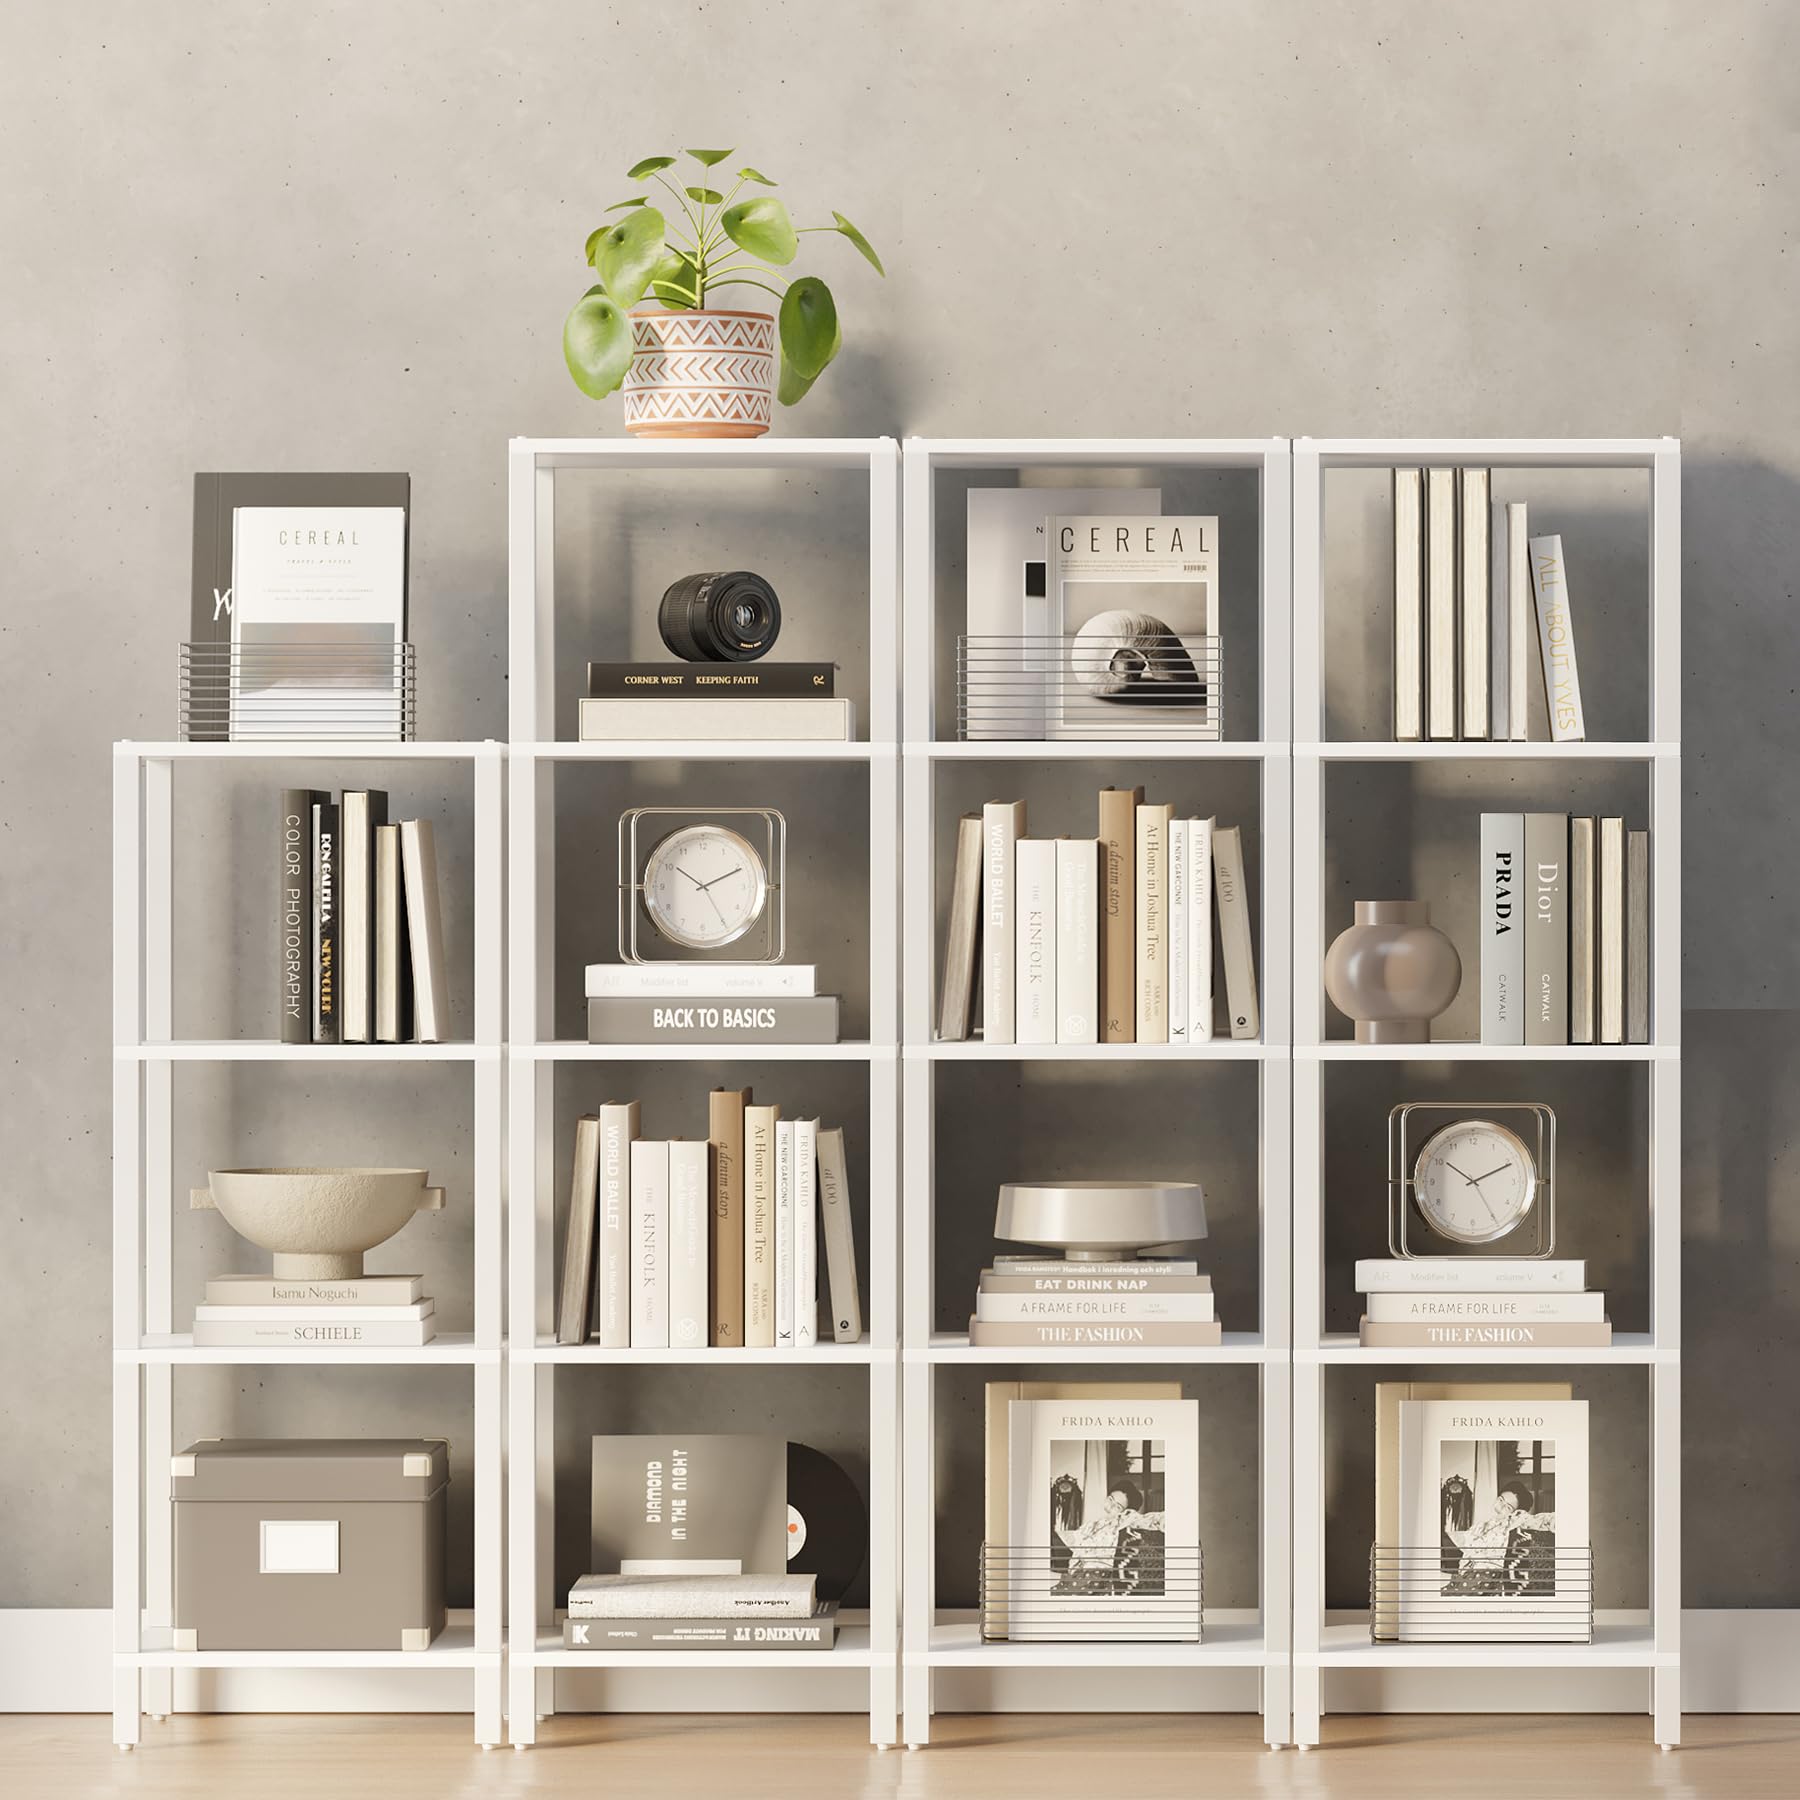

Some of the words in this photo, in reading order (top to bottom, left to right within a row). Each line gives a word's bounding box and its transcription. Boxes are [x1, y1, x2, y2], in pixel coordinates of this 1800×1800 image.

[279, 530, 359, 546] CEREAL
[1061, 527, 1209, 552] CEREAL
[1537, 556, 1559, 592] ALL
[1544, 602, 1570, 669] ABOUT
[625, 675, 659, 685] CORNER
[661, 675, 684, 685] WEST
[696, 675, 731, 685] KEEPING
[733, 675, 759, 685] FAITH
[1553, 680, 1576, 730] YVES
[1146, 824, 1160, 838] At
[285, 814, 301, 876] COLOR
[320, 833, 332, 861] RON
[991, 824, 1004, 875] WORLD
[665, 863, 674, 871] 10
[1109, 849, 1124, 884] denim
[1146, 841, 1160, 877] Home
[1146, 879, 1160, 890] in
[1496, 852, 1512, 936] PRADA
[1537, 862, 1558, 923] Dior
[991, 878, 1004, 928] BALLET
[1105, 884, 1122, 917] story
[1146, 893, 1160, 931] Joshua
[285, 888, 301, 1019] PHOTOGRAPHY
[320, 938, 332, 968] NEW
[1030, 911, 1042, 984] KINFOLK
[1146, 934, 1160, 960] Tree
[1541, 974, 1550, 1022] CATWALK
[653, 1008, 694, 1028] BACK
[697, 1008, 719, 1028] TO
[723, 1008, 776, 1028] BASICS
[754, 1125, 766, 1139] At
[606, 1125, 619, 1178] WORLD
[754, 1143, 766, 1178] Home
[1434, 1158, 1444, 1166] 10
[719, 1150, 733, 1185] denim
[754, 1181, 766, 1192] in
[1430, 1178, 1435, 1186] 9
[606, 1181, 619, 1230] BALLET
[715, 1187, 729, 1220] story
[754, 1194, 766, 1234] Joshua
[643, 1212, 656, 1288] KINFOLK
[754, 1237, 766, 1263] Tree
[272, 1285, 307, 1299] Isamu
[309, 1287, 358, 1302] Noguchi
[1035, 1279, 1062, 1290] EAT
[1067, 1279, 1112, 1290] DRINK
[1117, 1279, 1148, 1290] NAP
[1020, 1302, 1029, 1314] A
[1032, 1302, 1073, 1314] FRAME
[1076, 1302, 1098, 1314] FOR
[1102, 1302, 1126, 1314] LIFE
[1411, 1303, 1419, 1314] A
[1422, 1303, 1463, 1314] FRAME
[1467, 1303, 1489, 1314] FOR
[1492, 1303, 1518, 1314] LIFE
[294, 1327, 362, 1340] SCHIELE
[1038, 1327, 1072, 1342] THE
[1075, 1327, 1144, 1342] FASHION
[1427, 1328, 1461, 1342] THE
[1464, 1328, 1535, 1342] FASHION
[1061, 1416, 1103, 1427] FRIDA
[1108, 1416, 1154, 1427] KAHLO
[1452, 1417, 1493, 1427] FRIDA
[1498, 1417, 1544, 1427] KAHLO
[671, 1449, 688, 1490] NIGHT
[646, 1460, 663, 1523] DIAMOND
[671, 1498, 688, 1524] THE
[671, 1527, 688, 1540] IN
[733, 1627, 751, 1641] IT
[754, 1627, 820, 1641] MAKING
